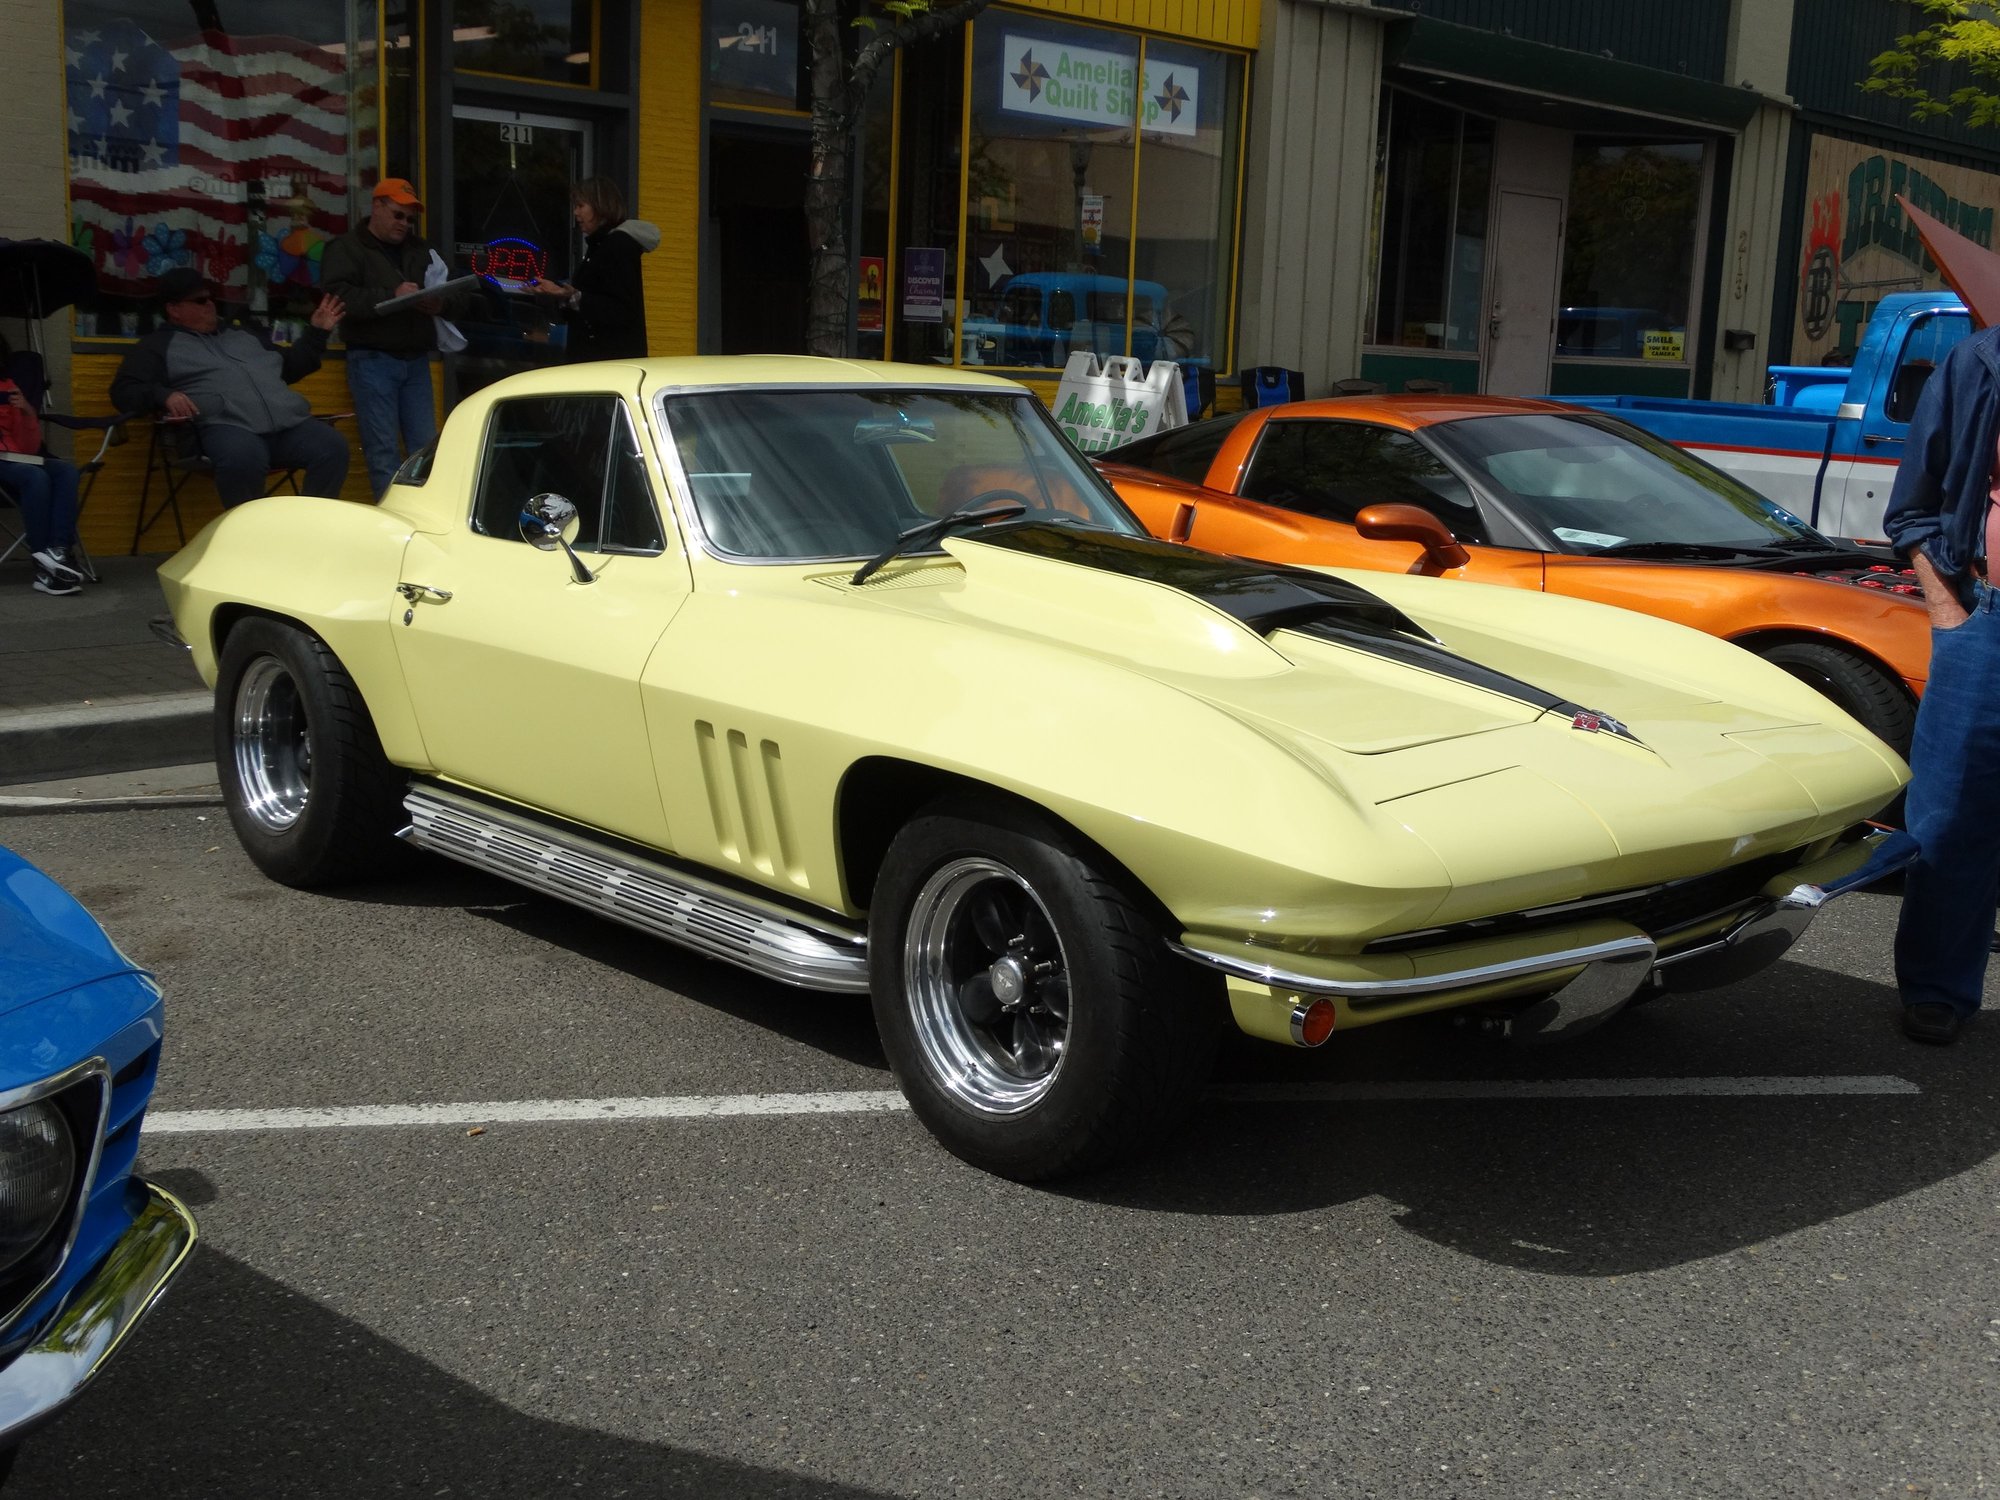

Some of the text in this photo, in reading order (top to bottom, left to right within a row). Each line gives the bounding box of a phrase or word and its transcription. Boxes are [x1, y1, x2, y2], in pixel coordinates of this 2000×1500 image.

[737, 22, 777, 56] 211
[1056, 52, 1150, 91] Amelias
[1045, 79, 1099, 112] Quilt
[502, 125, 530, 143] 211
[471, 246, 547, 280] OPEN
[908, 277, 940, 285] DISCOVER
[1647, 336, 1674, 344] SMILE
[1056, 392, 1149, 434] Amelia's
[1062, 426, 1133, 452] Qui
